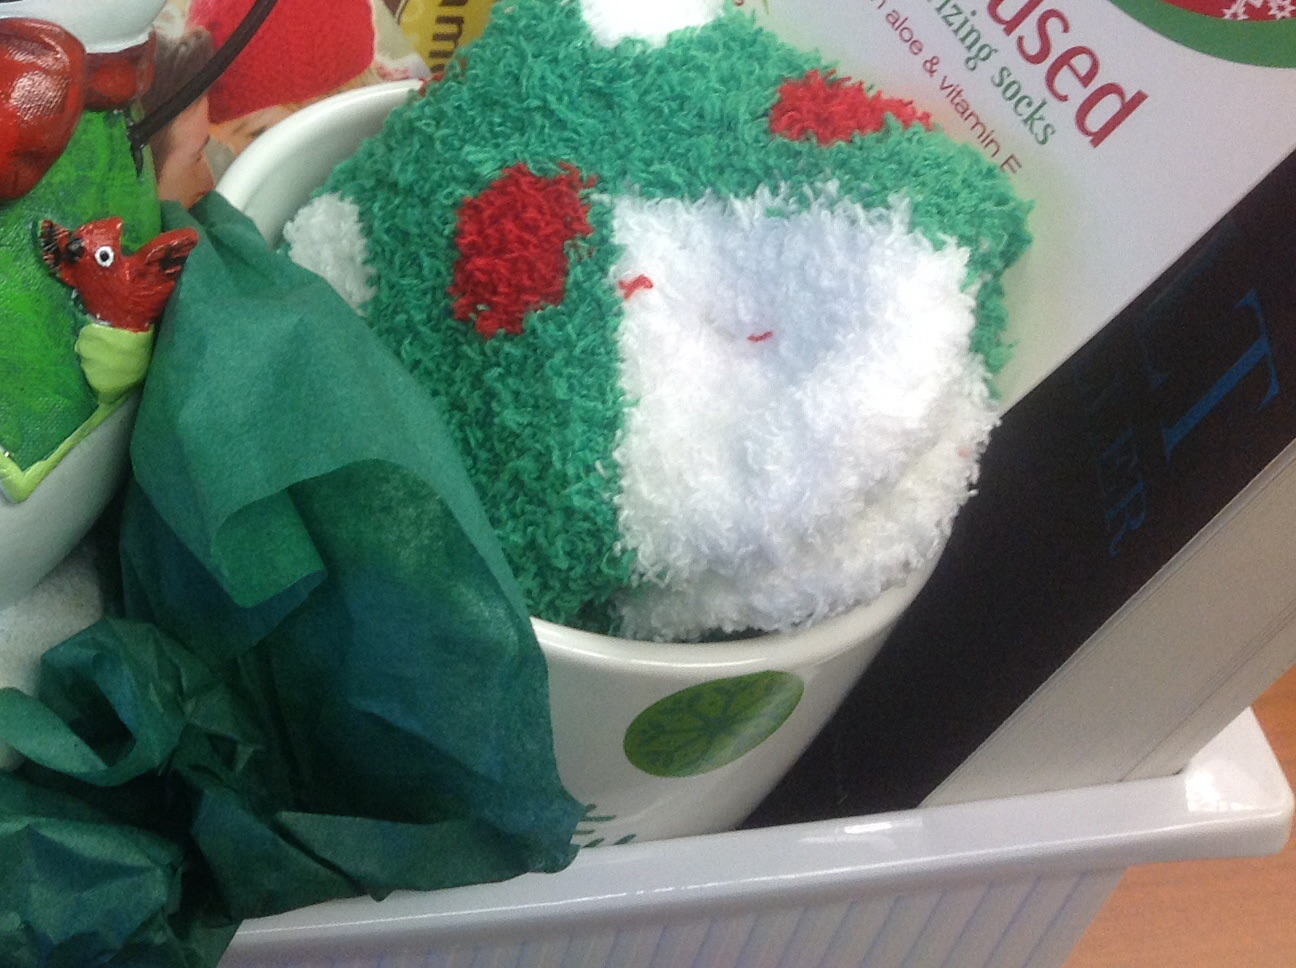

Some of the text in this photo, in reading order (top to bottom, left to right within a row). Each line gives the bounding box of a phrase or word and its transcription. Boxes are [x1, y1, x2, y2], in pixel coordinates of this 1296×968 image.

[886, 9, 923, 55] aloe
[923, 55, 940, 77] &
[939, 76, 1001, 157] vitamin
[991, 66, 1057, 146] socks
